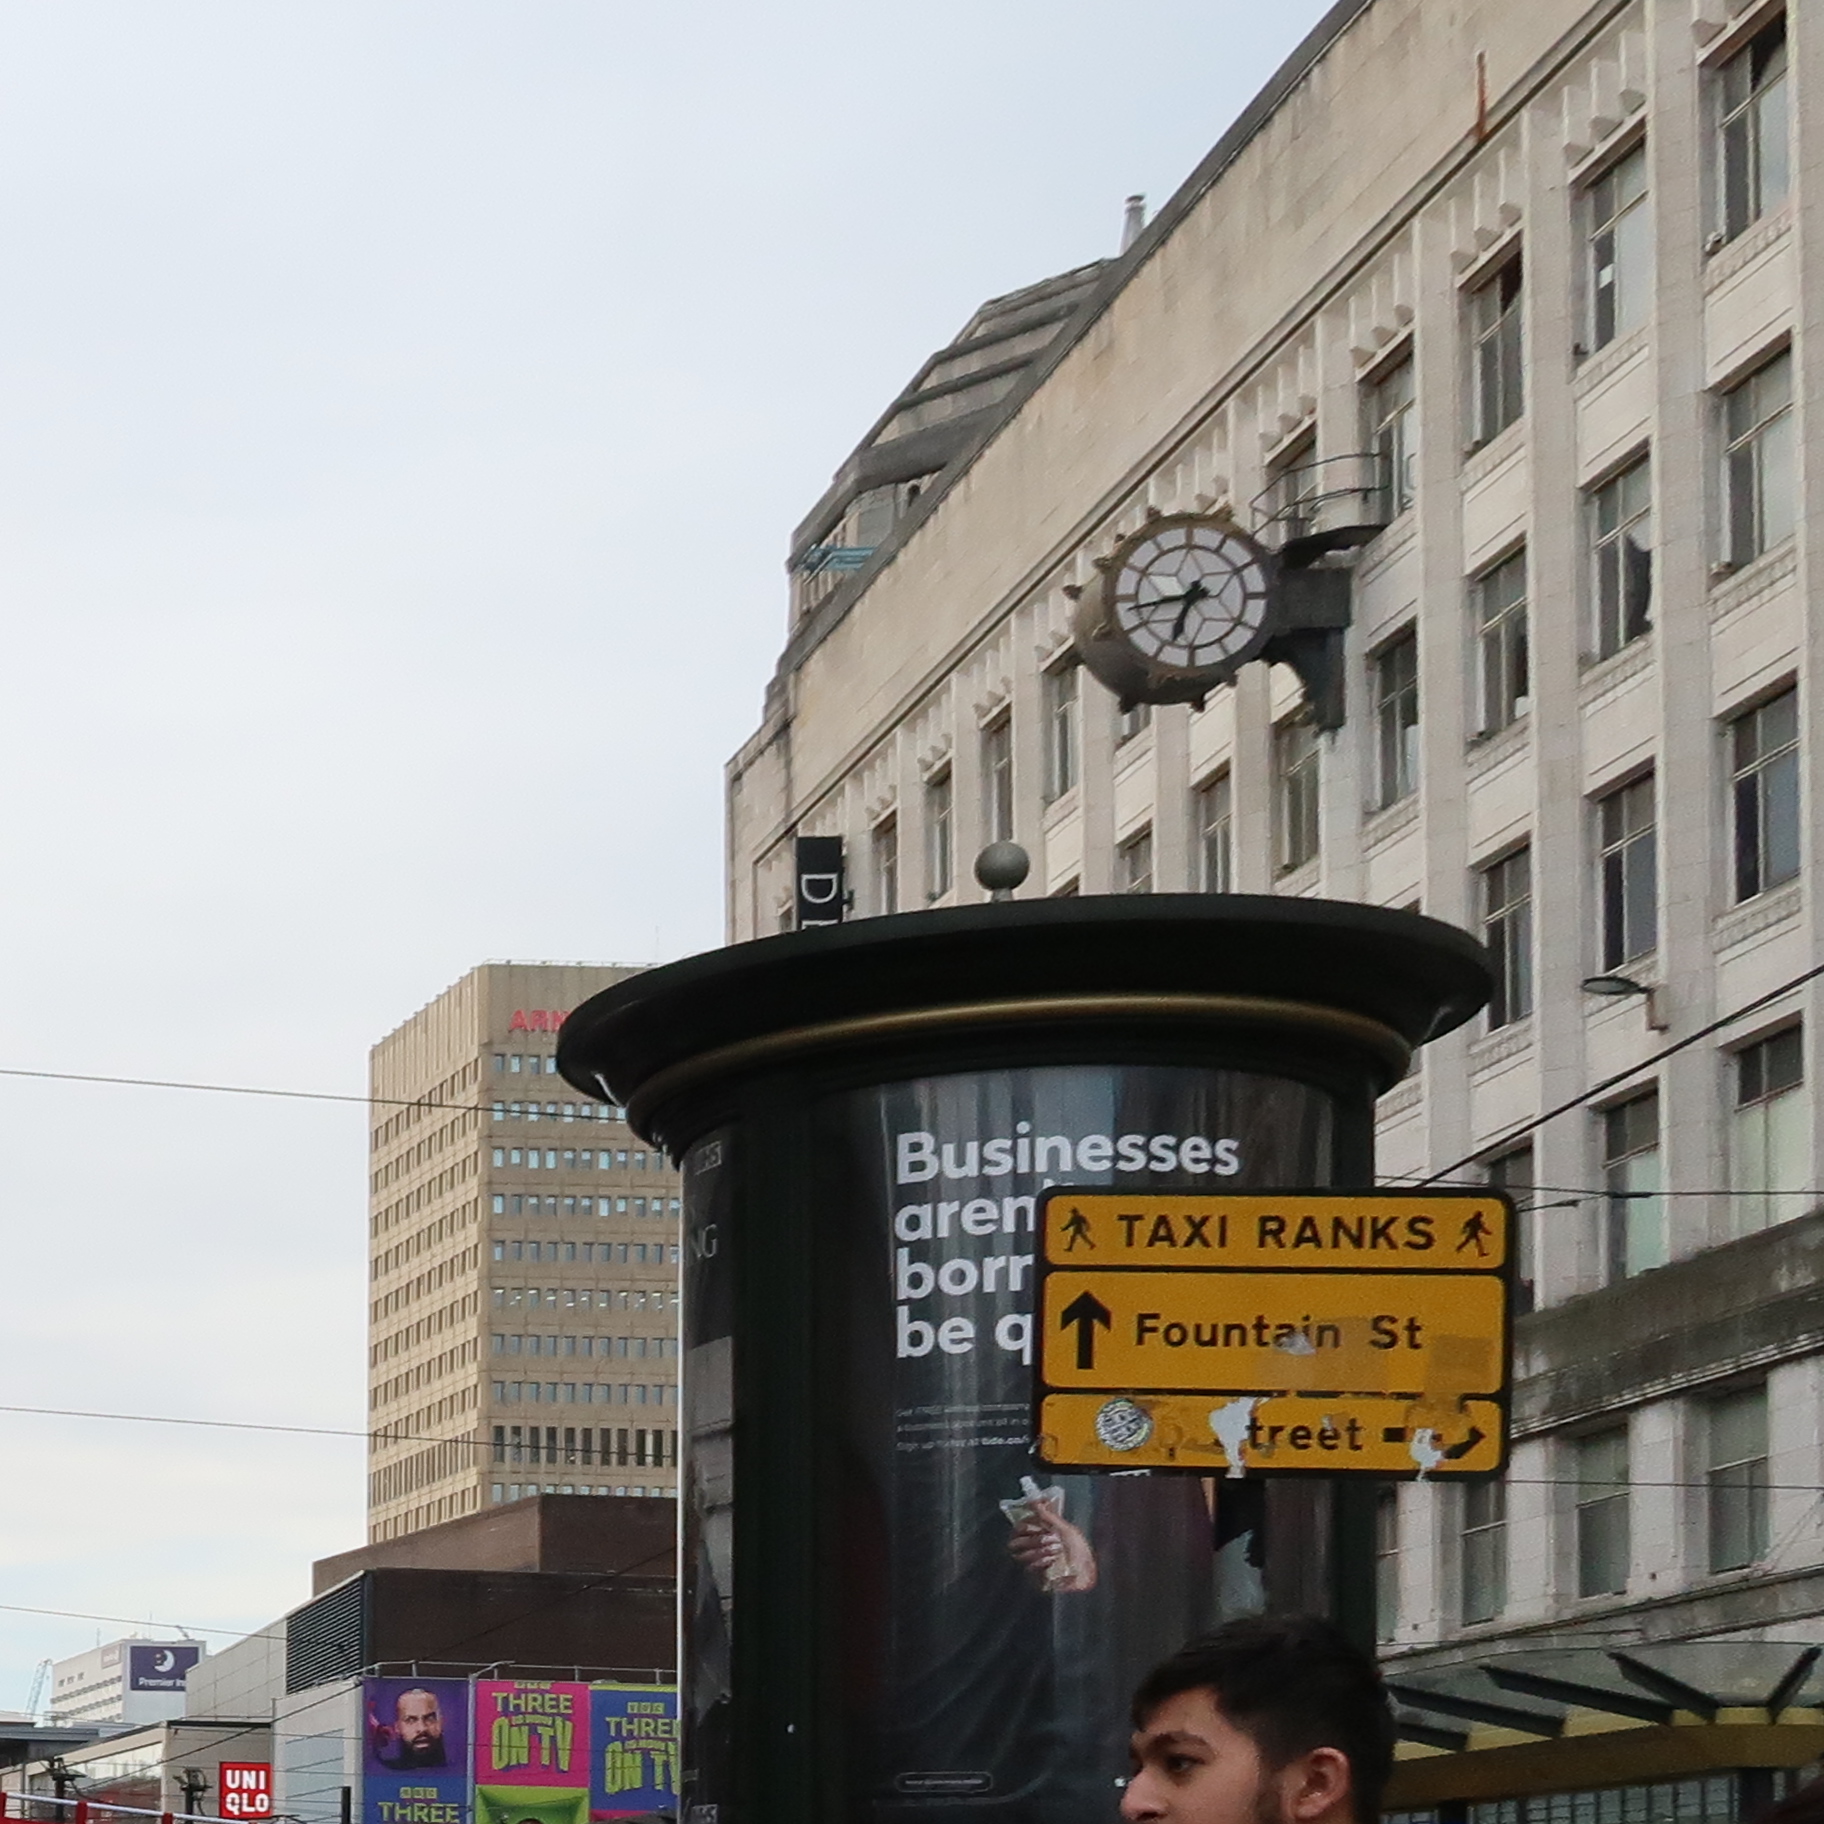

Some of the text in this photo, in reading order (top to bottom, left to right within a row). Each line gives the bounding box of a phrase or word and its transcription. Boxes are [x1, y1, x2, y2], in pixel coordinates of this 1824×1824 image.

[896, 1121, 1242, 1185] Businesses
[1116, 1213, 1436, 1251] TAXI RANKS
[895, 1305, 976, 1359] be
[1134, 1312, 1424, 1350] Fountain St
[491, 1692, 574, 1714] THREE
[491, 1715, 574, 1773] ON TV
[225, 1769, 266, 1790] UNI
[604, 1740, 643, 1796] ON
[225, 1792, 269, 1816] QLO
[377, 1801, 460, 1824] THREE
